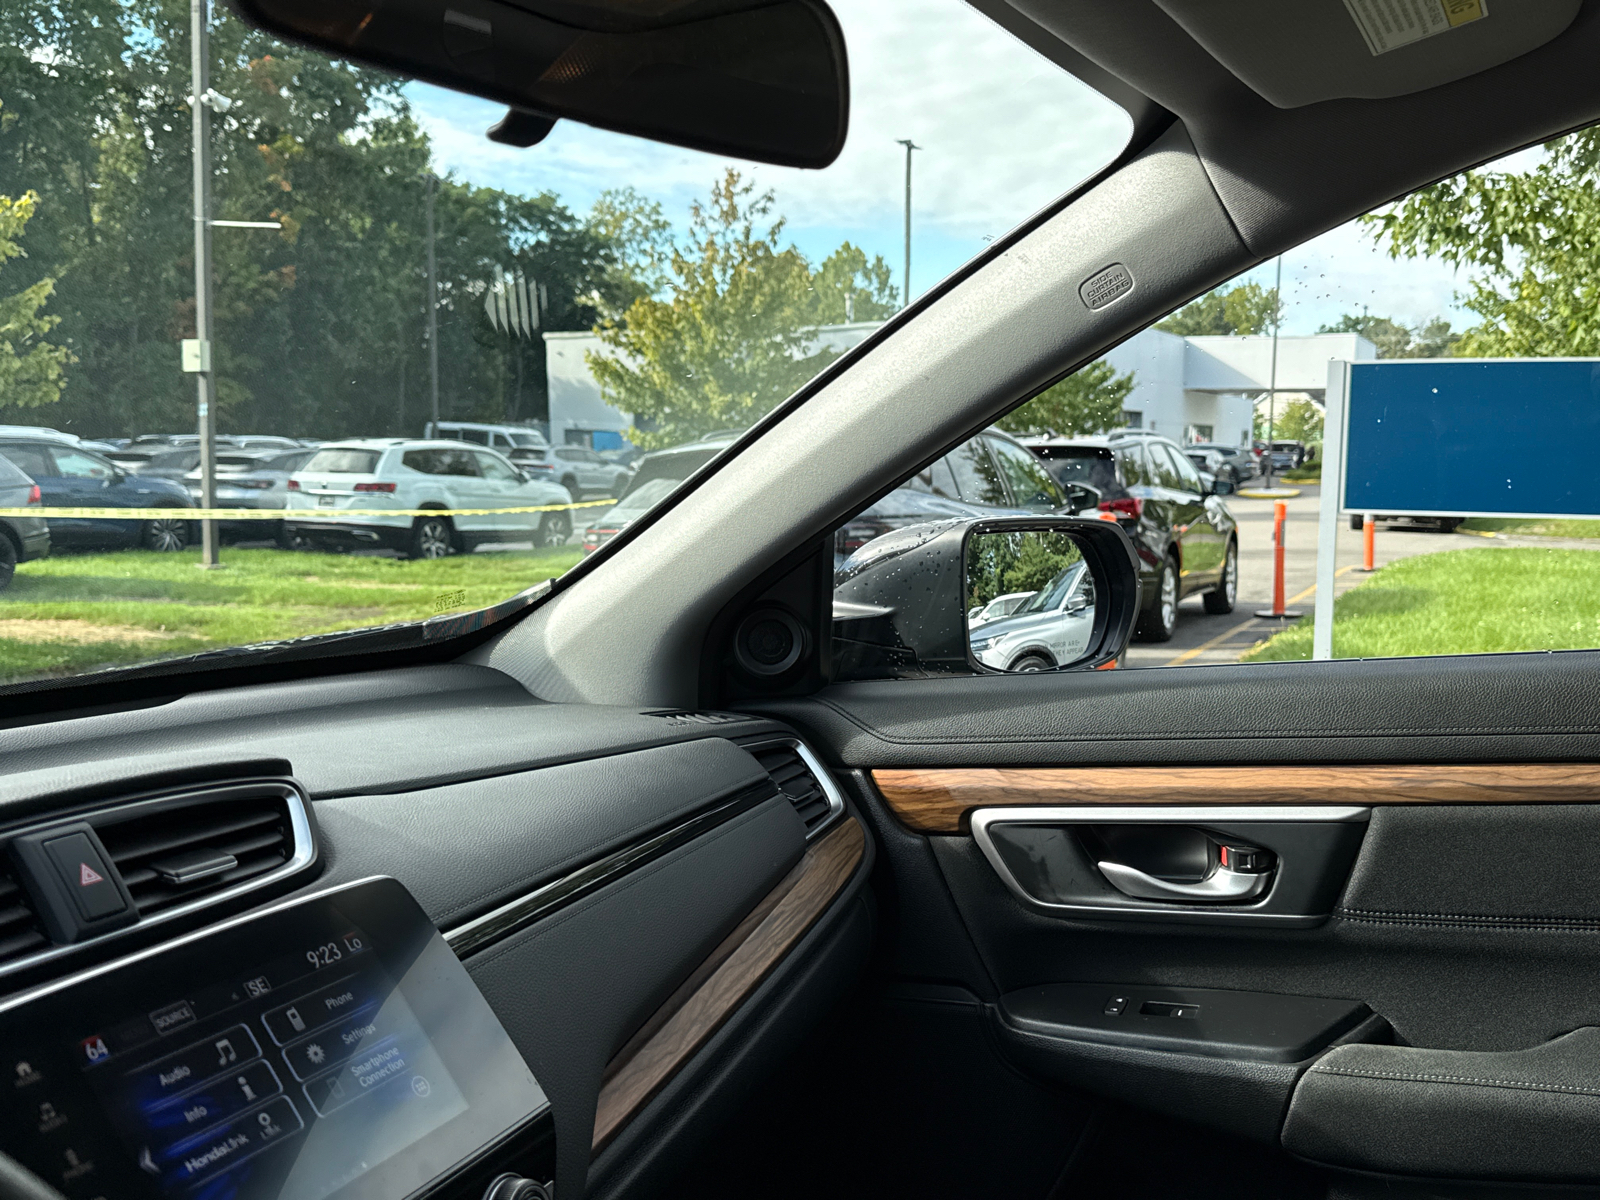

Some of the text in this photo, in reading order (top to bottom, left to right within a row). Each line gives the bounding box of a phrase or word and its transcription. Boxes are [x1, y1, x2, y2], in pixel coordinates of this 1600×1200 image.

[1087, 272, 1124, 298] CURTAIN
[1091, 271, 1113, 288] SIDE
[1092, 280, 1130, 306] AIRBAG
[1066, 647, 1083, 655] APPEAR
[306, 937, 363, 969] 9:23 Lo
[249, 978, 268, 996] SE
[325, 991, 354, 1010] Phone
[156, 1006, 191, 1029] SOURCE
[341, 1023, 376, 1045] Settings
[85, 1038, 109, 1061] 64
[351, 1046, 399, 1077] Smartphone
[359, 1058, 405, 1088] Connection
[159, 1065, 191, 1087] Audio
[184, 1106, 208, 1123] Info
[184, 1133, 250, 1173] HondaLink
